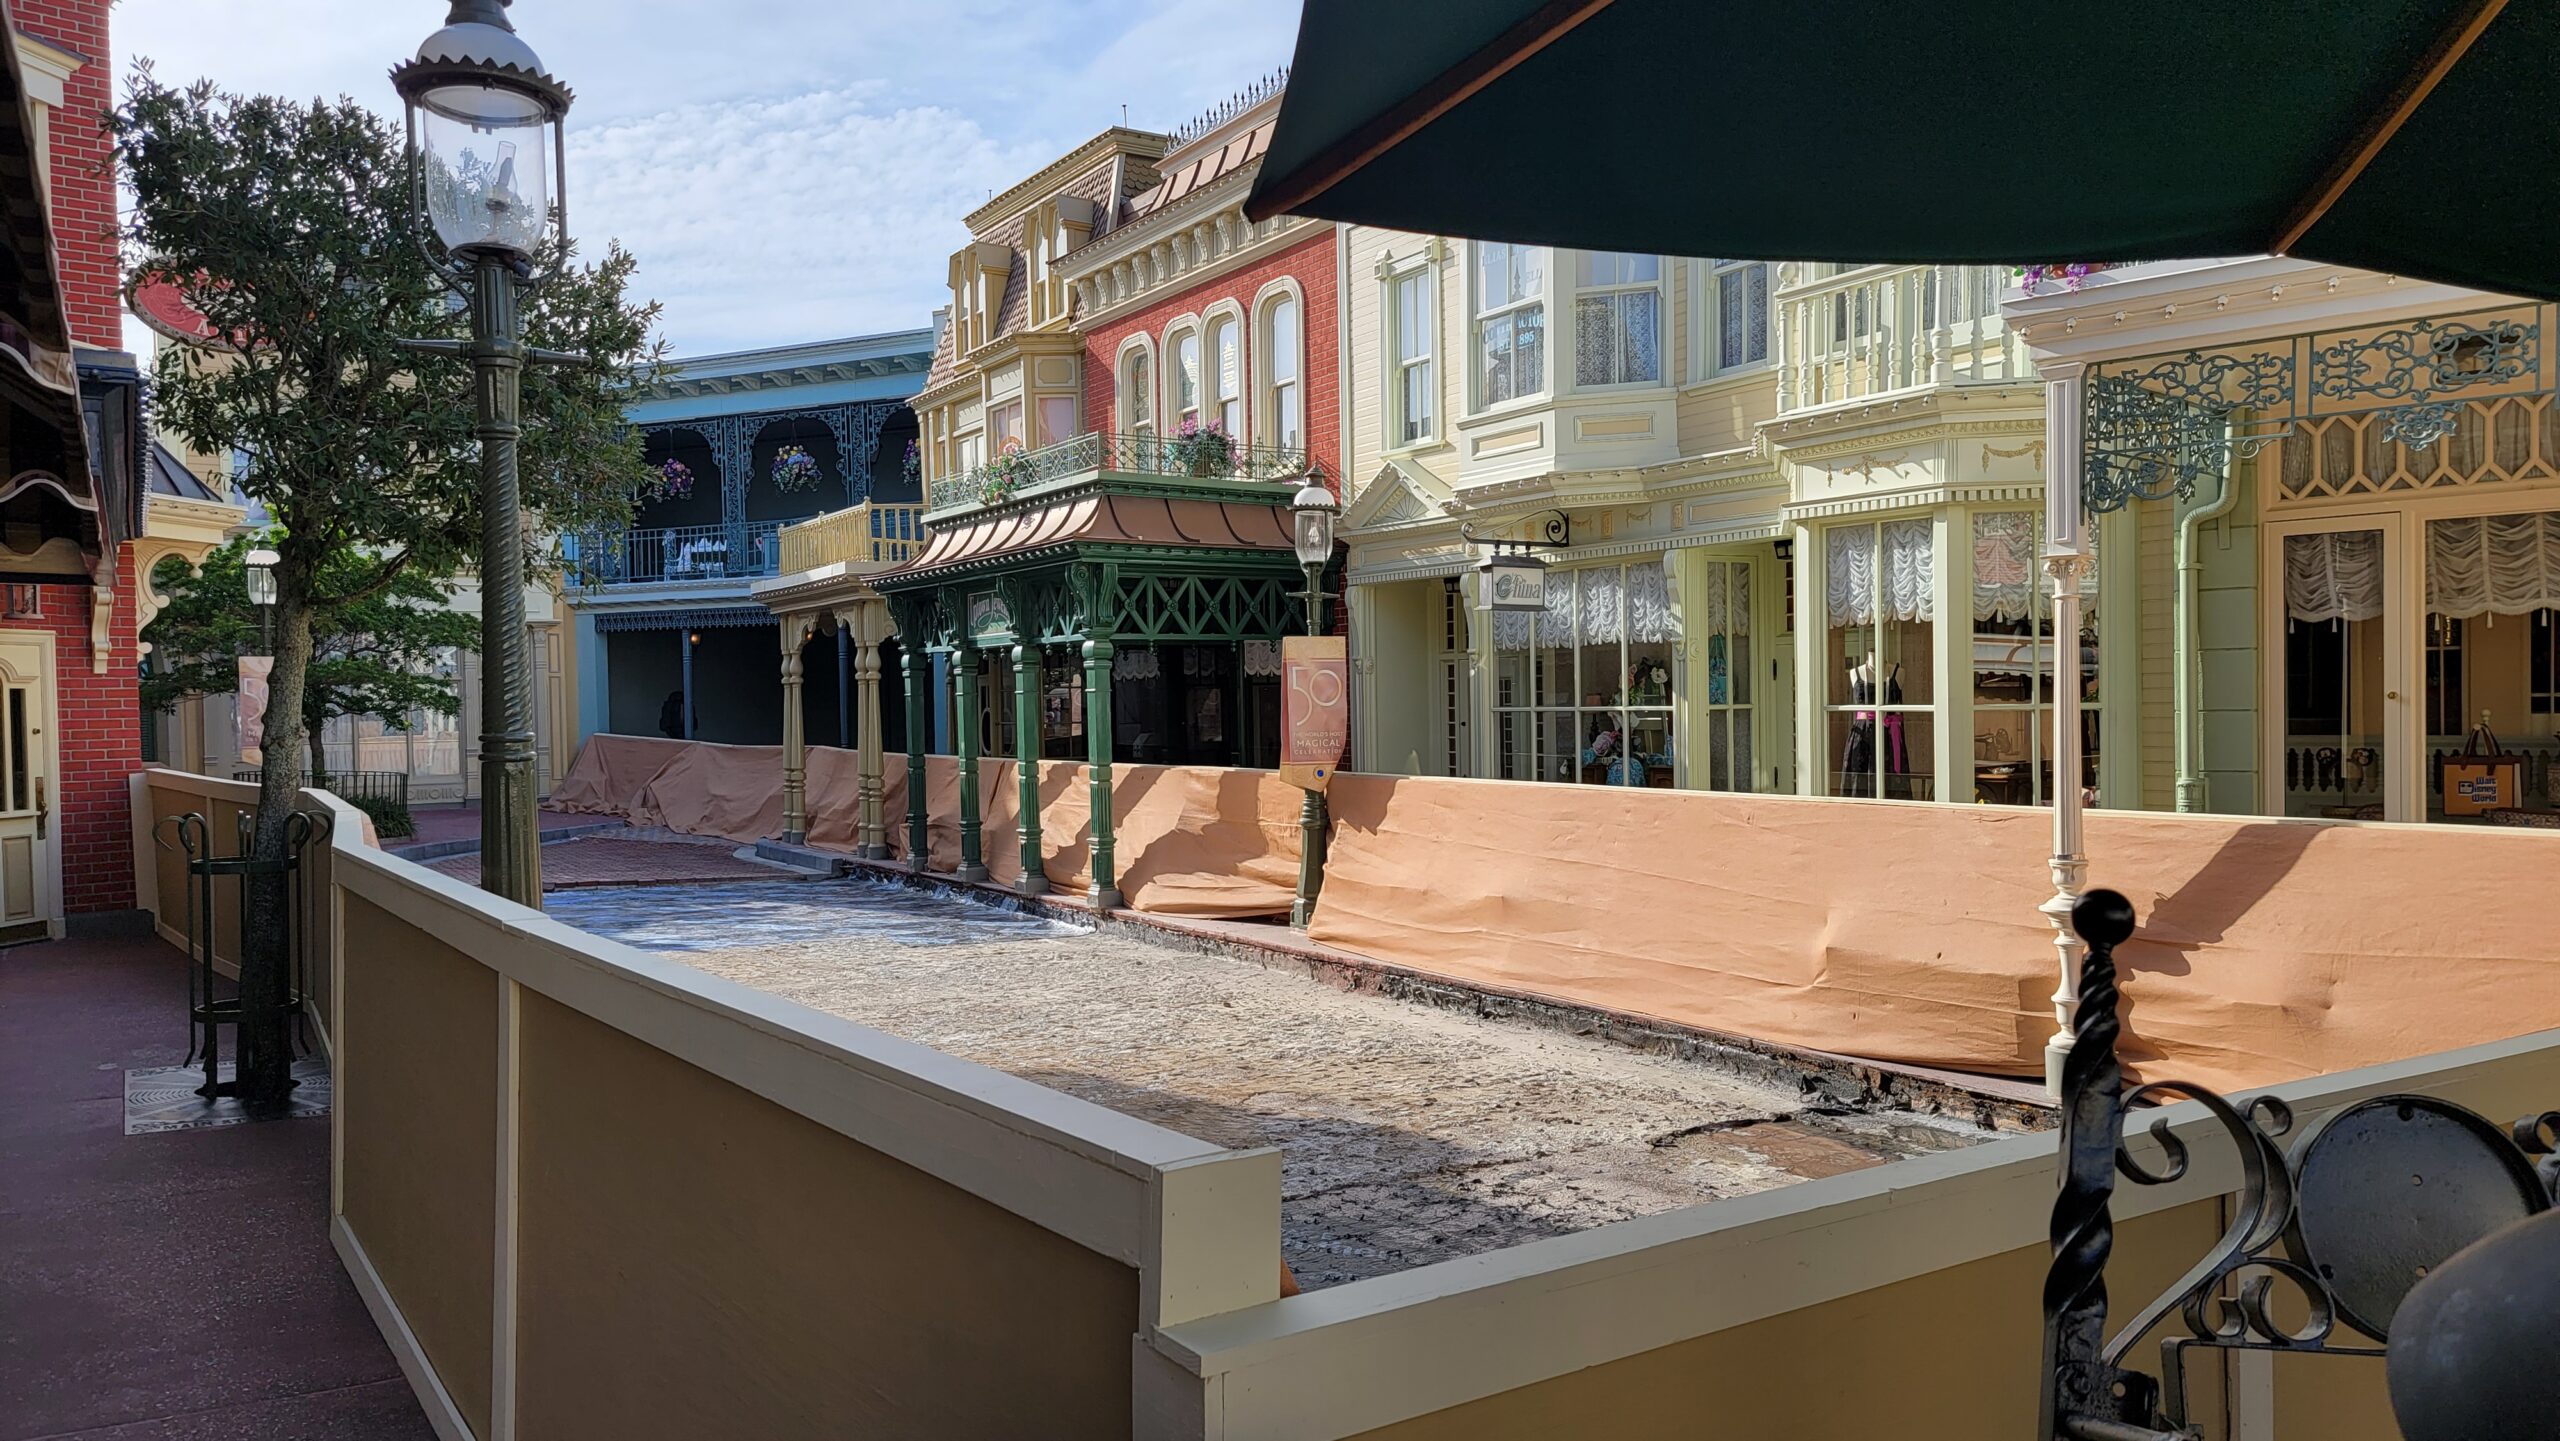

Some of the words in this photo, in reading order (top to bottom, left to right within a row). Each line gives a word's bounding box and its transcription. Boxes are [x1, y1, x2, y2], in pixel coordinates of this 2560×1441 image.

[1292, 666, 1342, 726] 50
[1297, 739, 1341, 748] MAGICAL
[2471, 794, 2497, 803] World
[163, 1120, 213, 1130] MAIN
